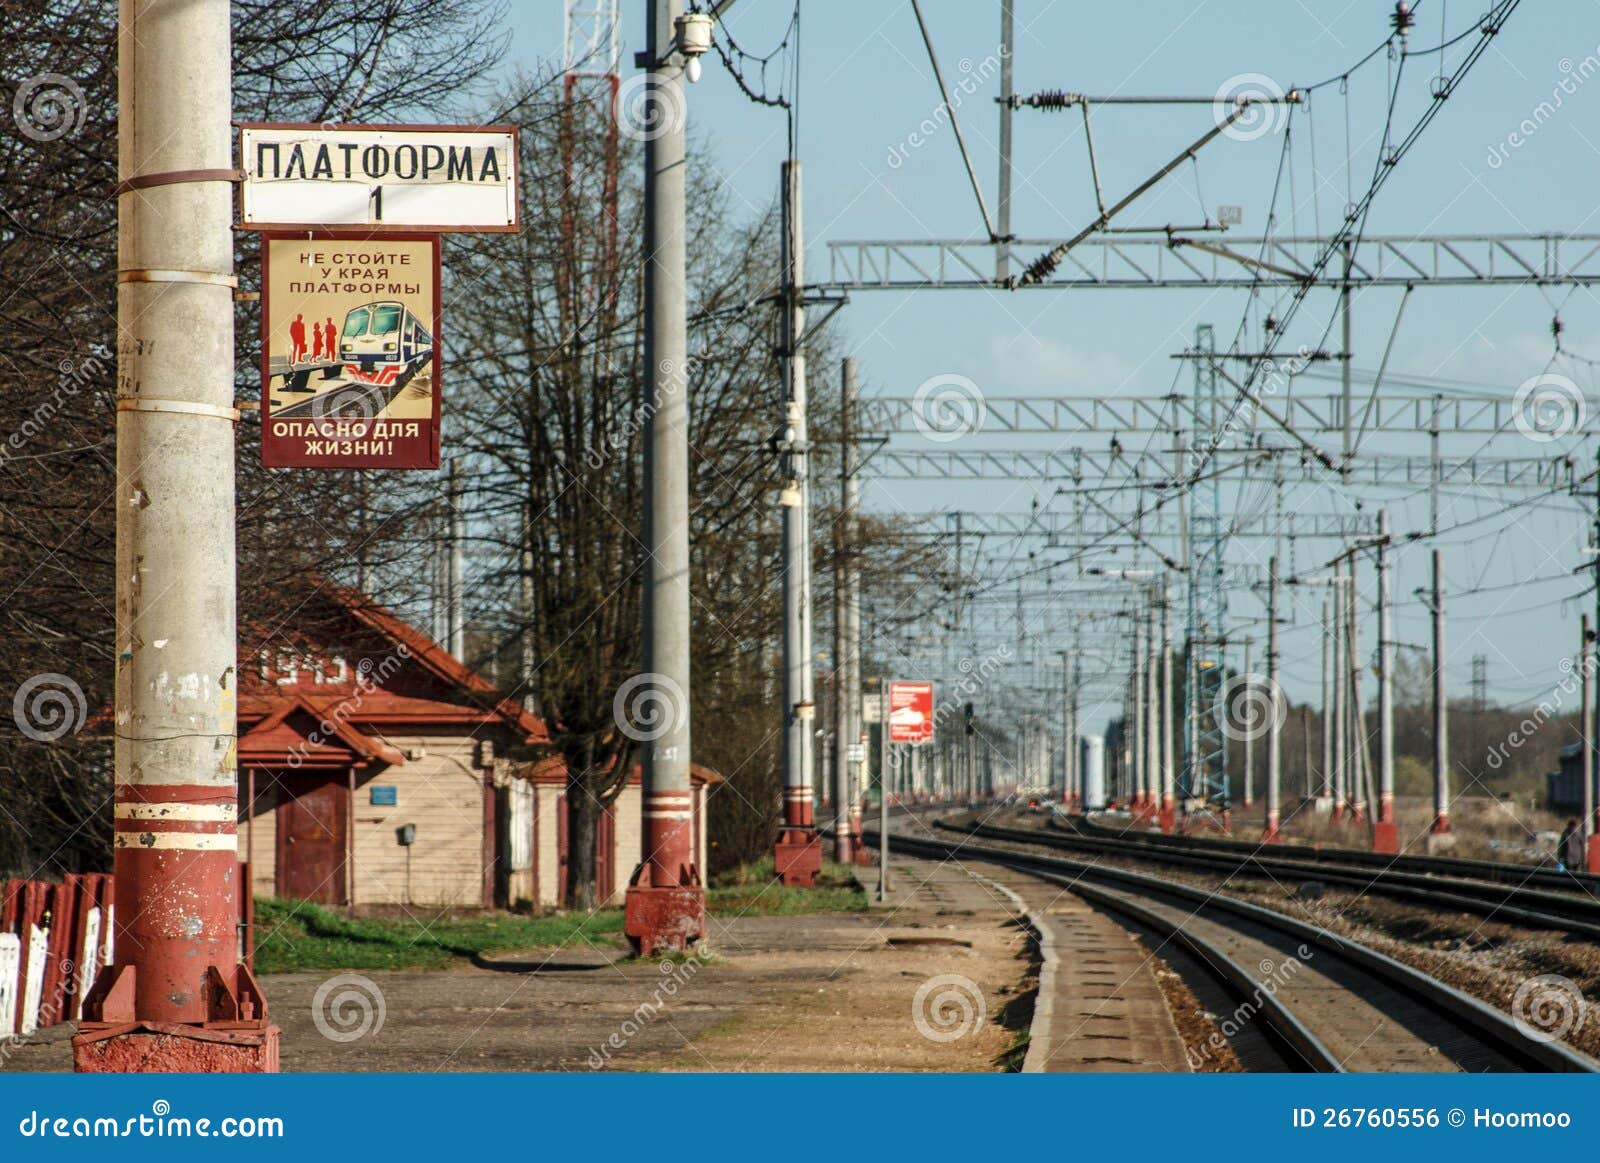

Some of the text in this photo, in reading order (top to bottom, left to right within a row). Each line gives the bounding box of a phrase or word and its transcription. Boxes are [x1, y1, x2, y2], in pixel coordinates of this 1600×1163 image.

[257, 143, 501, 181] ПЛАТФОРМА
[370, 185, 382, 220] 1
[300, 251, 411, 265] НЕ СТОЙТЕ
[321, 268, 389, 280] У КРАЯ
[290, 282, 420, 294] ПЛАТФОРМЫ
[273, 422, 419, 439] ОПАСНО ДЛЯ
[305, 441, 393, 456] ЖИЗНИ!
